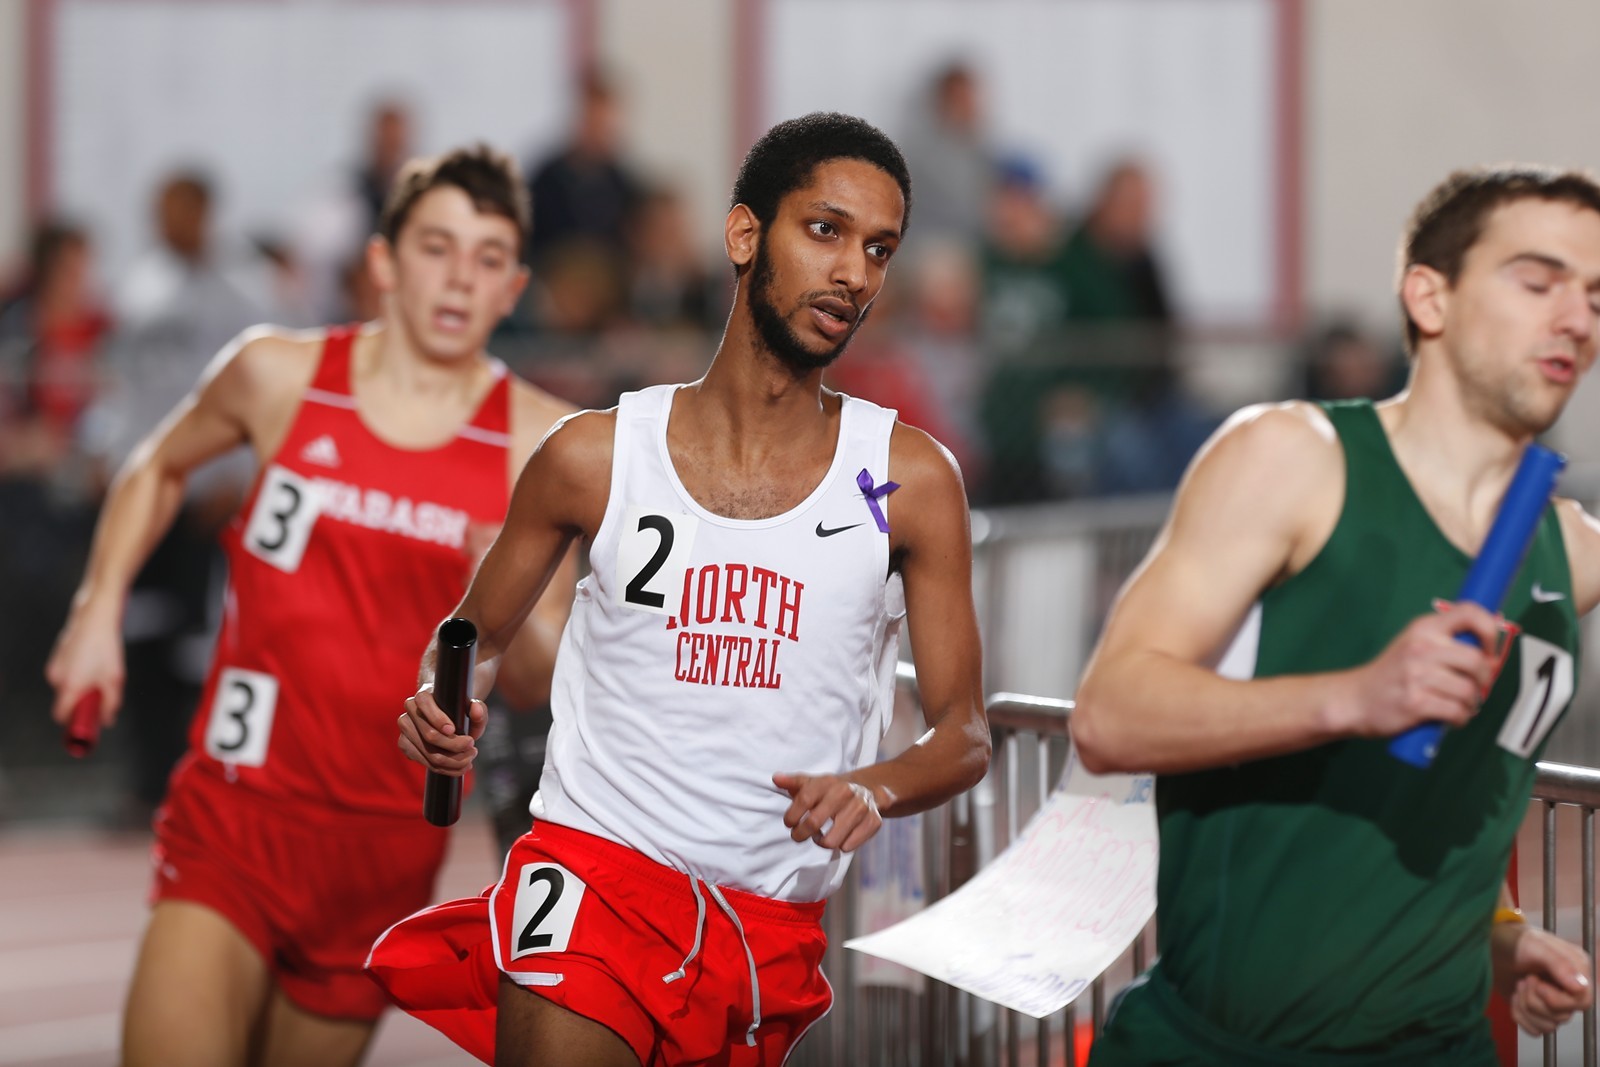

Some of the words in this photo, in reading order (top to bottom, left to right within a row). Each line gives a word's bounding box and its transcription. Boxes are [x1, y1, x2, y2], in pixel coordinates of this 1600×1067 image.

[256, 482, 302, 552] 3
[625, 514, 675, 608] 2
[666, 563, 804, 642] NORTH
[675, 631, 781, 689] CENTRAL
[216, 680, 256, 751] 3
[1521, 654, 1557, 750] 1
[517, 867, 565, 952] 2
